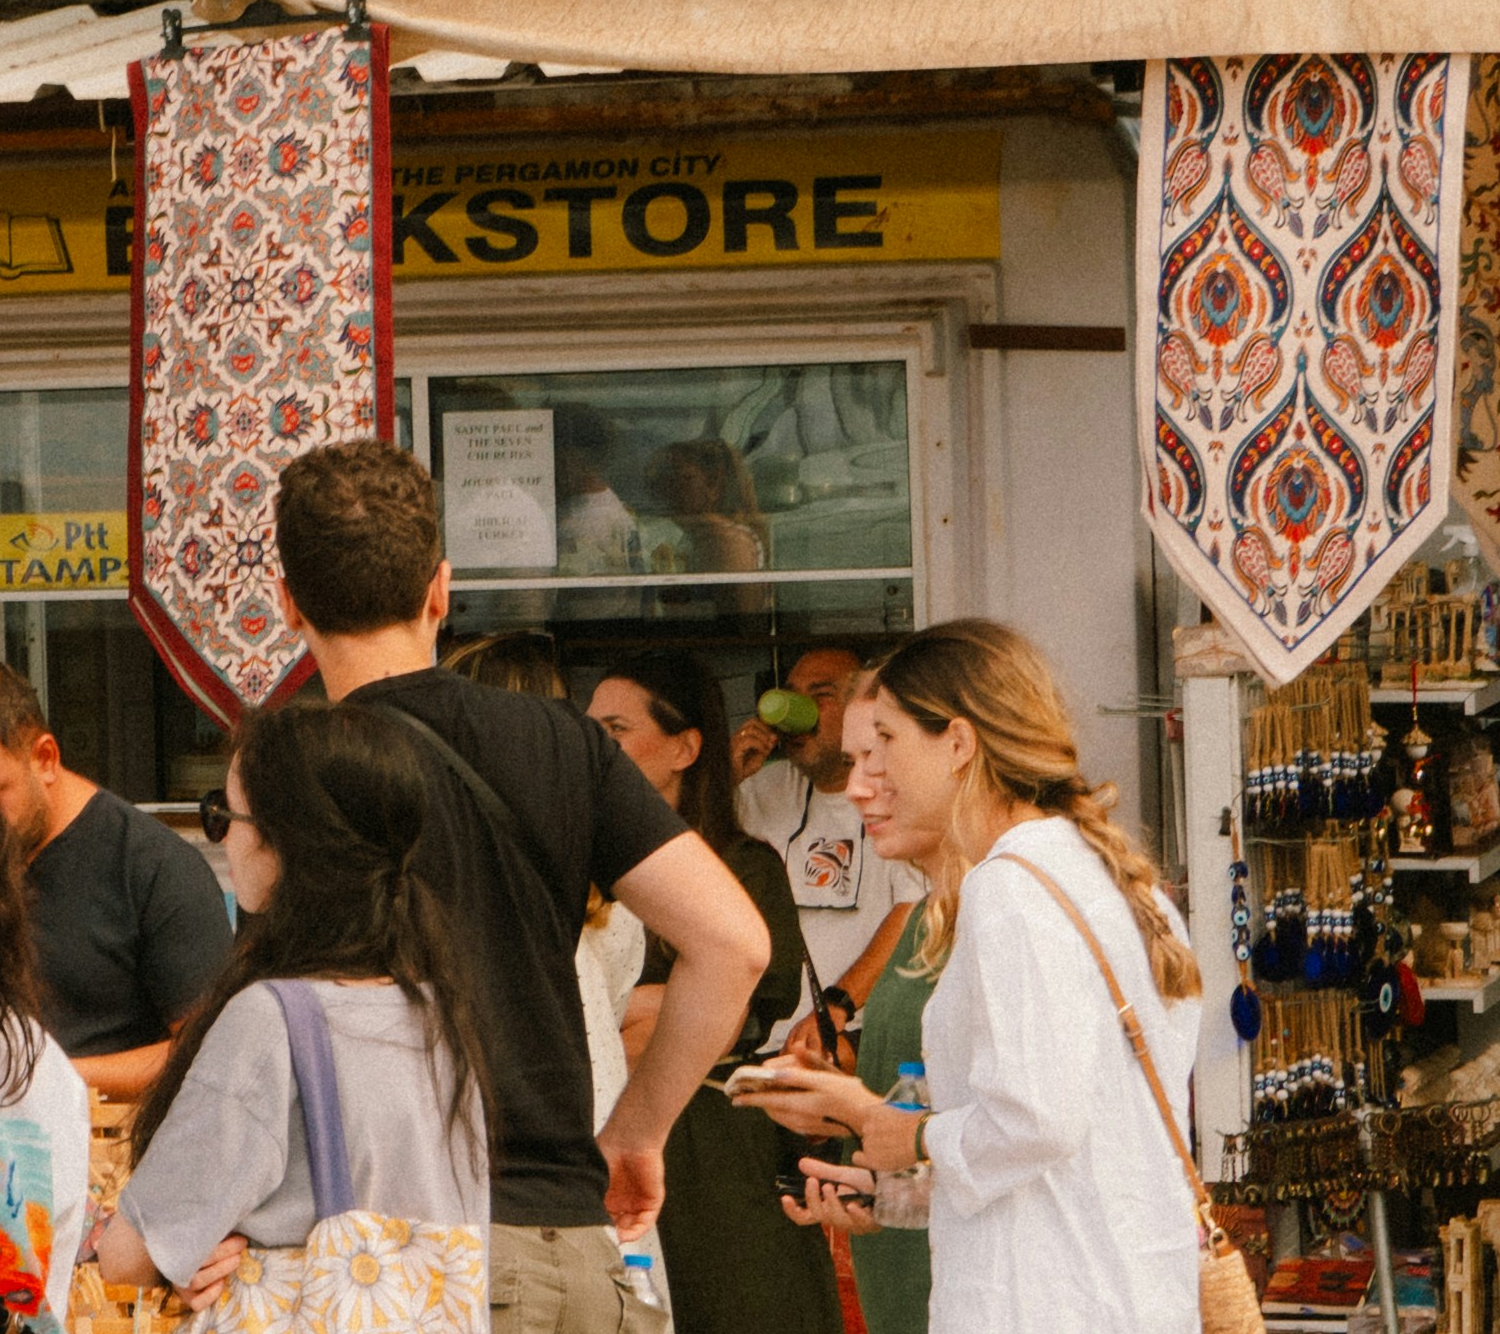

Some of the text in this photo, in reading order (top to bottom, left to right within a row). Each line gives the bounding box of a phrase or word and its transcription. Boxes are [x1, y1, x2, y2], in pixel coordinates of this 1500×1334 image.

[455, 156, 639, 184] PERGAMON
[649, 150, 722, 177] CİTY
[106, 174, 884, 276] KSTORE
[455, 424, 489, 435] SAINT
[469, 438, 532, 448] THE SEVEN
[467, 450, 533, 461] CHURCHES
[65, 521, 108, 550] Ptt
